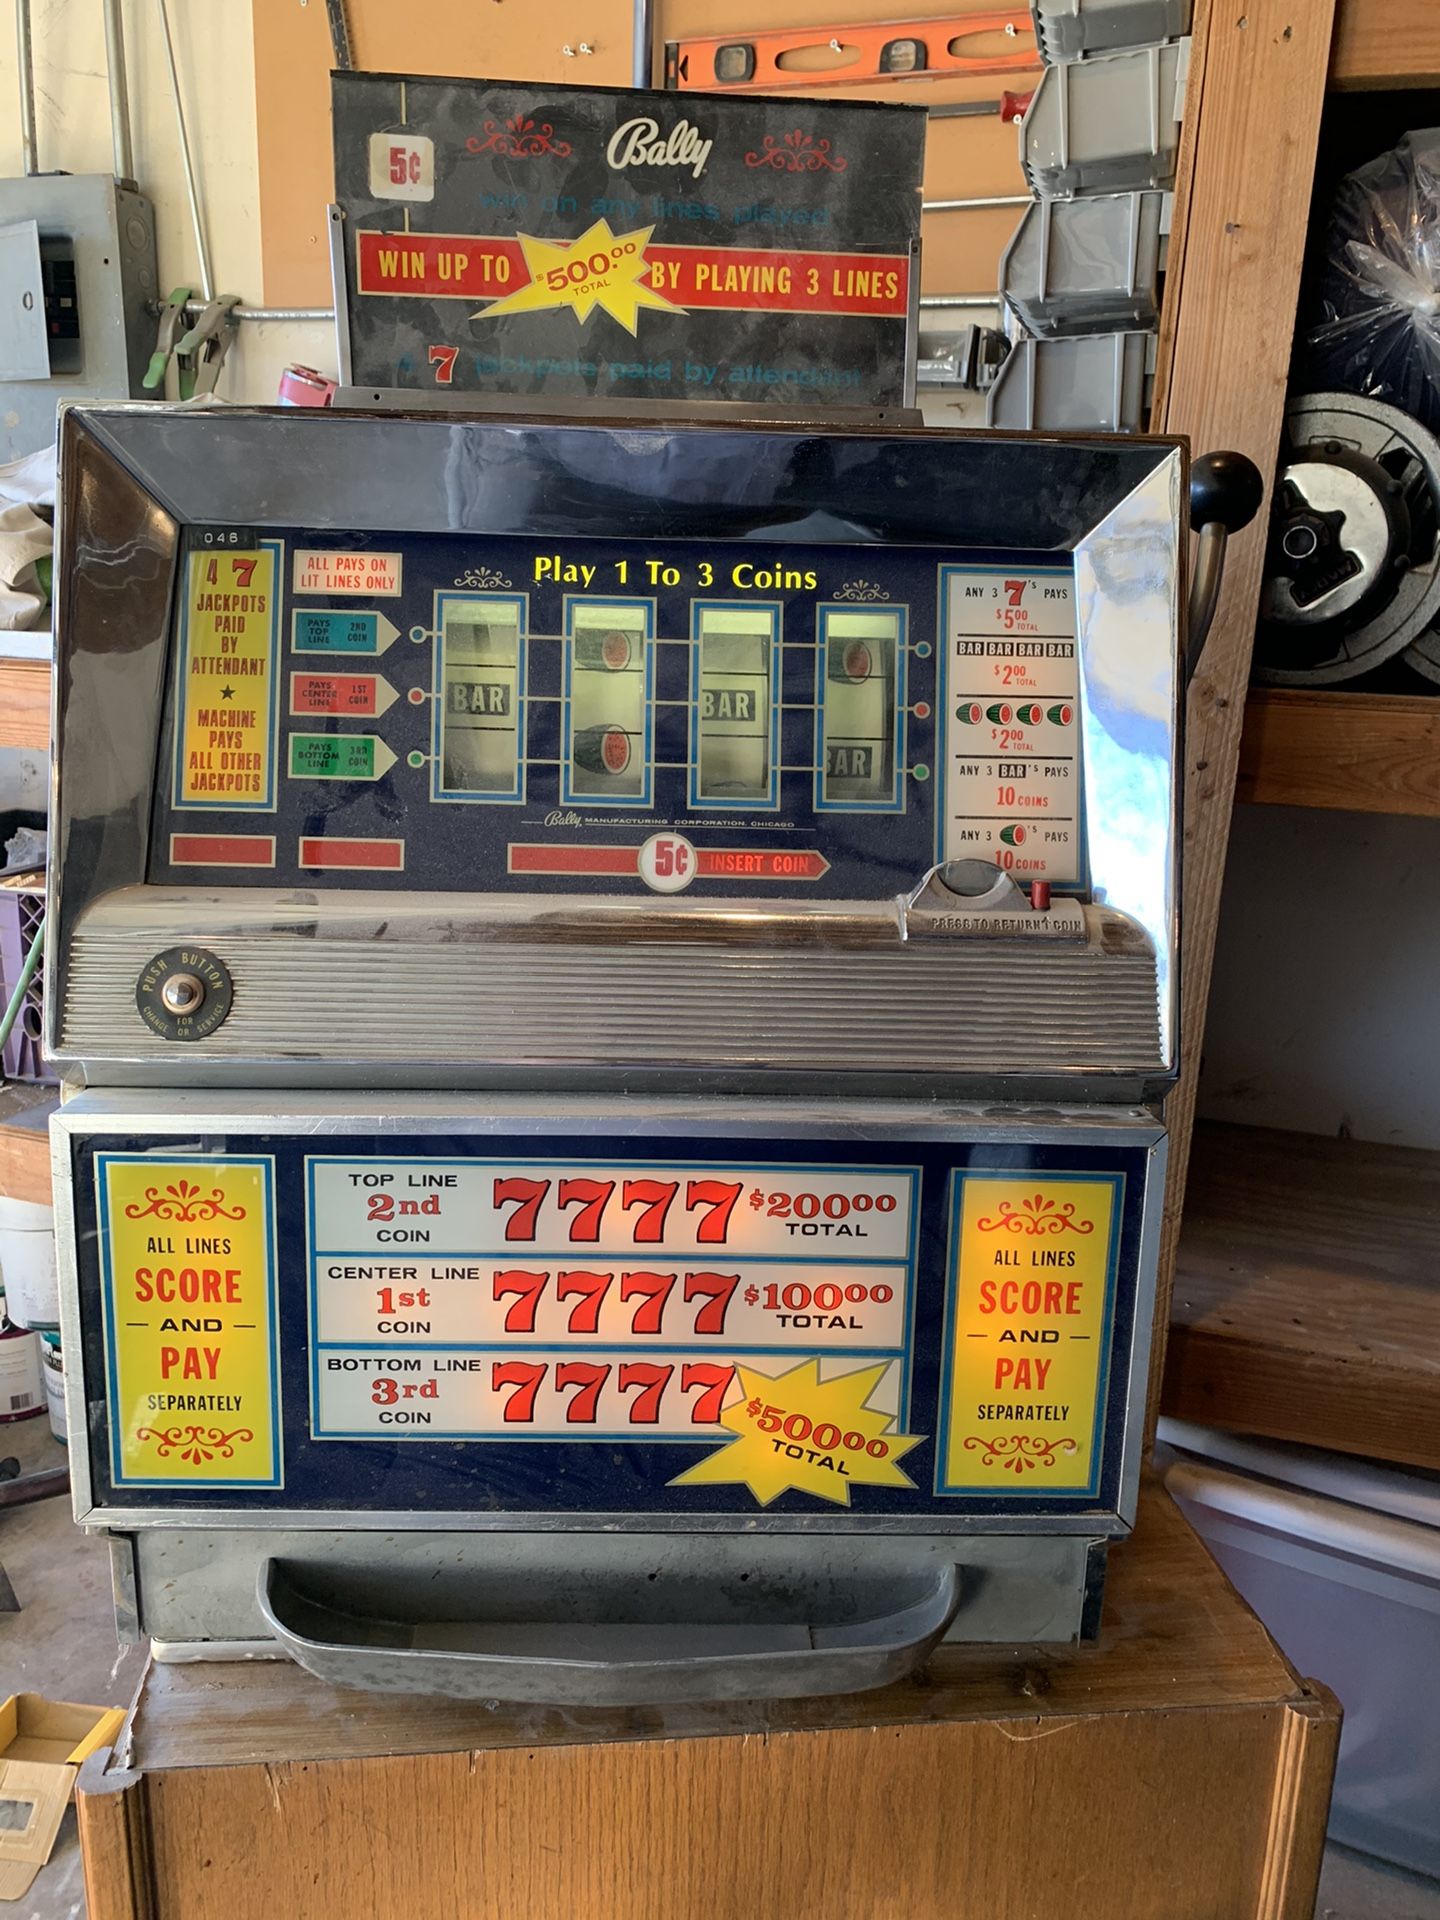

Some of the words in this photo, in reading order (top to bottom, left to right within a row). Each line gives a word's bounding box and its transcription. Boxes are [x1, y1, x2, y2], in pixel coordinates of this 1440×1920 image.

[606, 117, 712, 179] Bally
[389, 146, 422, 186] 5¢
[542, 196, 578, 212] on
[591, 198, 641, 221] any
[654, 197, 719, 221] lines
[734, 203, 831, 227] played
[378, 250, 425, 279] WIN
[438, 252, 469, 281] UP
[481, 254, 510, 284] TO
[572, 278, 611, 298] TOTAL
[651, 261, 681, 290] BY
[696, 263, 792, 295] PLAYING
[807, 267, 820, 296] 3
[832, 270, 899, 300] LINES
[428, 344, 460, 384] 7
[610, 358, 671, 384] paid
[684, 359, 718, 385] by
[203, 532, 238, 545] 046
[205, 558, 218, 586] 4
[232, 558, 256, 587] 7
[307, 557, 331, 571] ALL
[335, 557, 366, 573] PAYS
[370, 558, 388, 573] ON
[533, 556, 597, 589] Play
[614, 560, 629, 585] 1
[645, 560, 682, 586] To
[697, 563, 714, 588] 3
[731, 562, 819, 591] Coins
[301, 574, 319, 588] LIT
[326, 574, 361, 589] LINES
[366, 575, 396, 590] ONLY
[965, 587, 984, 598] ANY
[992, 587, 998, 599] 3
[1044, 588, 1068, 600] PAYS
[196, 595, 266, 614] JACKPOTS
[214, 615, 246, 633] PAID
[307, 618, 332, 628] PAYS
[309, 626, 329, 636] TOP
[349, 621, 368, 632] 2ND
[1016, 622, 1039, 632] TOTAL
[221, 636, 237, 654] BY
[307, 634, 331, 645] LINE
[347, 631, 369, 643] COIN
[958, 642, 983, 655] BAR
[988, 643, 1013, 656] BAR
[1018, 644, 1042, 656] BAR
[1047, 645, 1073, 657] BAR
[191, 657, 266, 677] ATTENDANT
[308, 681, 333, 690] PAYS
[351, 684, 368, 694] 1ST
[1016, 677, 1037, 687] TOTAL
[302, 690, 338, 699] CENTER
[308, 698, 331, 707] LINE
[347, 695, 369, 706] COIN
[453, 686, 505, 715] BAR
[702, 690, 750, 720] BAR
[197, 709, 256, 729] MACHINE
[209, 730, 243, 749] PAYS
[308, 742, 333, 752] PAYS
[1012, 741, 1034, 751] TOTAL
[189, 752, 216, 770] ALL
[220, 752, 261, 771] OTHER
[297, 751, 340, 761] BOTTOM
[307, 759, 330, 769] LINE
[347, 757, 369, 767] COIN
[959, 765, 980, 776] ANY
[986, 765, 993, 776] 3
[1044, 766, 1069, 777] PAYS
[190, 772, 261, 793] JACKPOTS
[996, 786, 1016, 807] 10
[1017, 795, 1049, 808] COINS
[543, 810, 583, 830] Bally
[584, 817, 669, 826] MANUFACTURING
[750, 820, 795, 829] CHICAGO
[960, 829, 981, 841] ANY
[985, 829, 992, 841] 3
[1044, 831, 1069, 843] PAYS
[654, 840, 688, 876] 5¢
[709, 854, 764, 872] INSERT
[772, 856, 809, 873] COIN
[994, 849, 1014, 870] 10
[1015, 858, 1047, 871] COINS
[931, 917, 972, 930] PRESS
[973, 918, 990, 930] TO
[994, 919, 1040, 931] RETURN
[1052, 919, 1082, 932] COIN
[142, 958, 168, 993] PUSH
[181, 952, 225, 990] BUTTON
[143, 1005, 169, 1034] CHANGE
[177, 1027, 190, 1037] OR
[196, 1003, 225, 1033] SERVICE
[176, 1016, 194, 1026] FOR
[348, 1174, 395, 1188] TOP
[408, 1174, 459, 1188] LINE
[366, 1193, 443, 1222] 2nd
[375, 1229, 431, 1243] COIN
[785, 1223, 869, 1238] TOTAL
[147, 1237, 176, 1254] ALL
[186, 1237, 232, 1255] LINES
[994, 1249, 1022, 1266] ALL
[1031, 1250, 1077, 1268] LINES
[327, 1266, 418, 1280] CENTER
[430, 1266, 480, 1281] LINE
[134, 1267, 243, 1304] SCORE
[375, 1287, 431, 1314] 1st
[978, 1280, 1085, 1316] SCORE
[159, 1318, 224, 1333] AND
[376, 1320, 432, 1334] COIN
[776, 1314, 864, 1330] TOTAL
[998, 1329, 1061, 1344] AND
[160, 1346, 222, 1380] PAY
[327, 1358, 422, 1372] BOTTOM
[433, 1359, 481, 1372] LINE
[994, 1357, 1053, 1391] PAY
[371, 1377, 441, 1407] 3rd
[147, 1394, 243, 1412] SEPARATELY
[378, 1411, 432, 1425] COIN
[977, 1403, 1071, 1422] SEPARATELY
[771, 1438, 852, 1476] TOTAL
